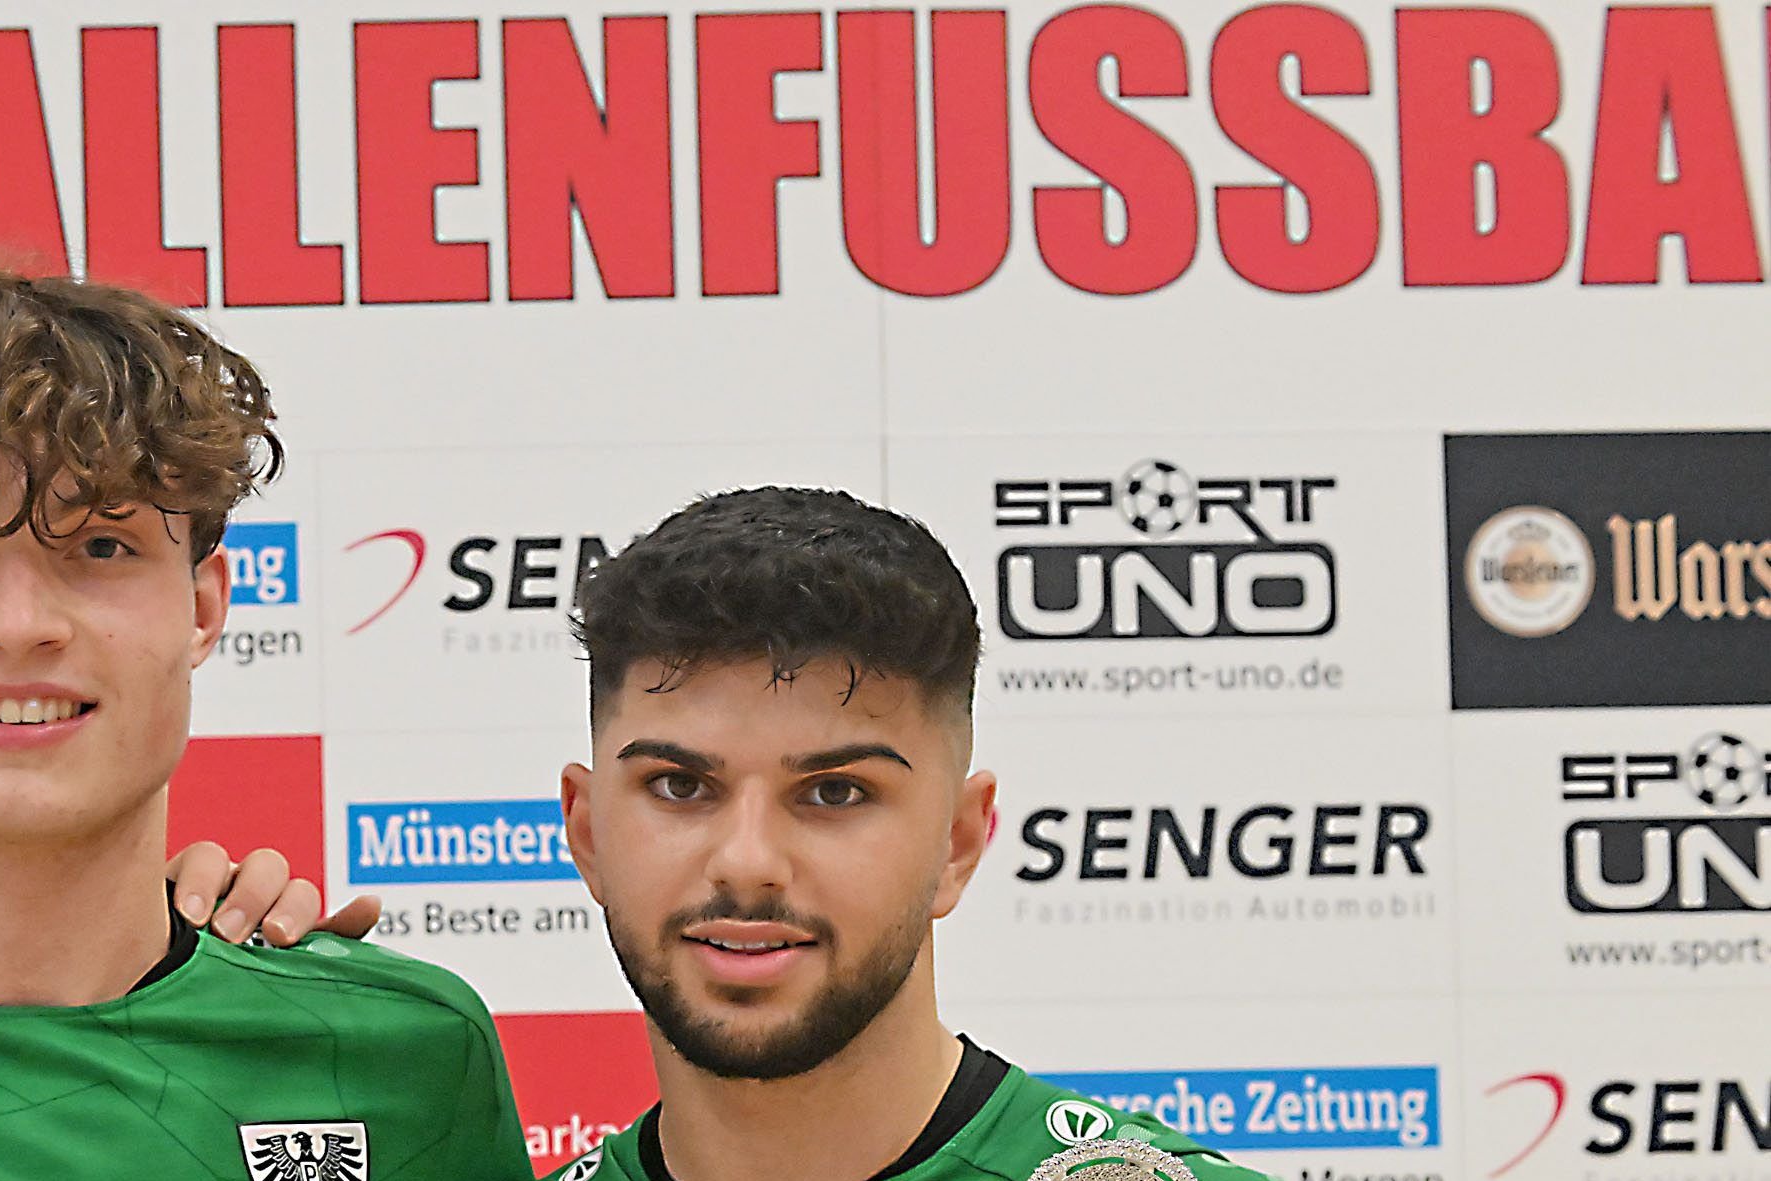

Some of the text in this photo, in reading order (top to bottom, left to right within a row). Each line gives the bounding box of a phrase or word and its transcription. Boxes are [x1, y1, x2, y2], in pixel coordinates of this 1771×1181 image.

[1007, 551, 1332, 637] UNO
[997, 658, 1344, 697] www.sport-uno.de
[1016, 804, 1432, 882] SENGER
[425, 903, 521, 934] Beste
[534, 905, 589, 932] am
[1247, 892, 1436, 919] Automobil
[1246, 1076, 1428, 1146] Zeitung
